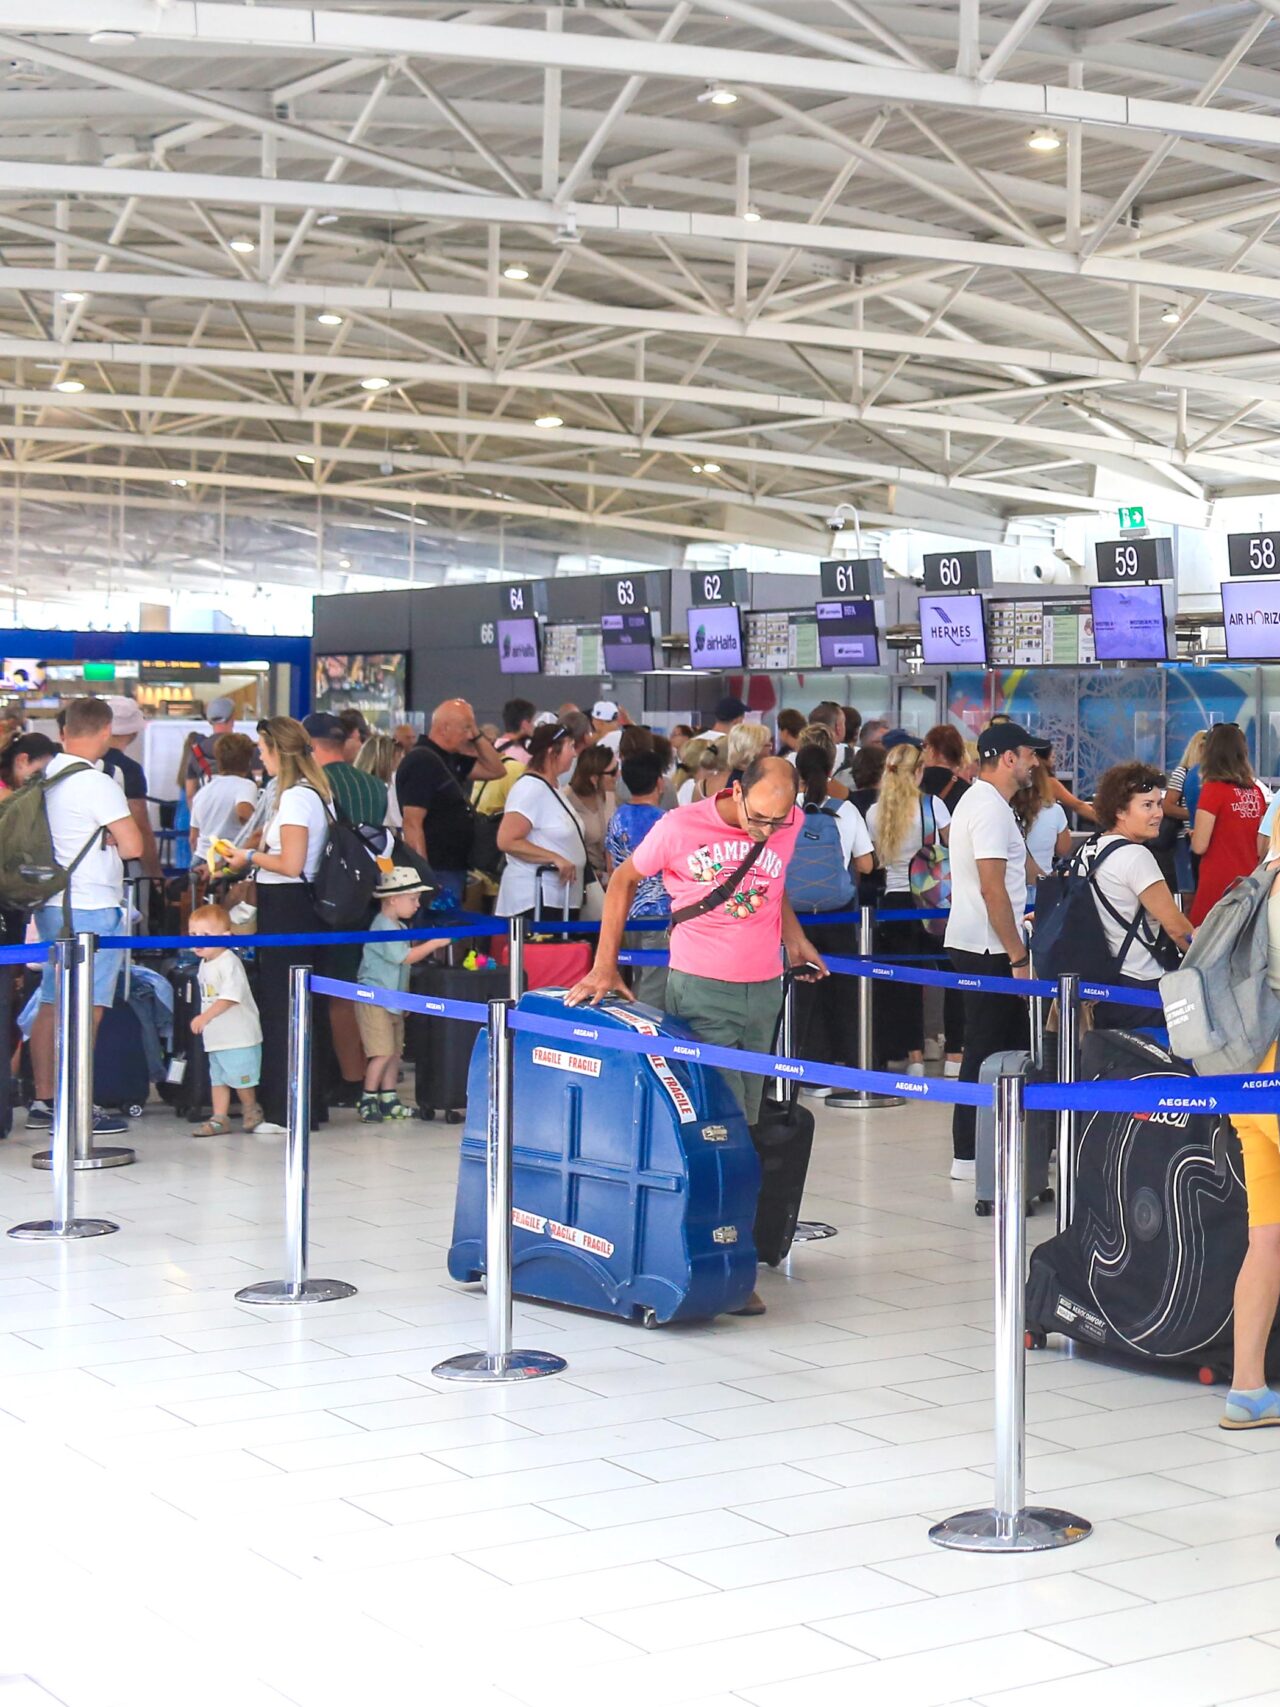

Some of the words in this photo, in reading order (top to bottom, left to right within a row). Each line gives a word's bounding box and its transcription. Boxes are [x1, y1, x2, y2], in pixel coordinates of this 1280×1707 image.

[1114, 546, 1138, 576] 59
[1249, 538, 1276, 569] 58
[836, 565, 854, 592] 61
[939, 558, 961, 585] 60
[617, 580, 634, 605] 63
[704, 575, 722, 600] 62
[510, 587, 524, 610] 64
[1229, 612, 1244, 626] AIR
[480, 623, 494, 644] 66
[707, 634, 738, 651] airHaifa
[931, 625, 971, 639] HERMES
[687, 841, 782, 879] CHAMPNS
[1084, 988, 1105, 996] AEGEAN
[573, 1028, 594, 1038] AEGEAN
[535, 1049, 561, 1064] FRAGILE
[569, 1056, 598, 1073] FRAGILE
[673, 1046, 696, 1056] AEGEAN
[774, 1064, 799, 1074] AEGEAN
[663, 1076, 692, 1115] FRAGILE
[895, 1082, 922, 1092] AEGEAN
[1158, 1098, 1206, 1107] AEGEAN
[583, 1235, 611, 1255] FRAGILE
